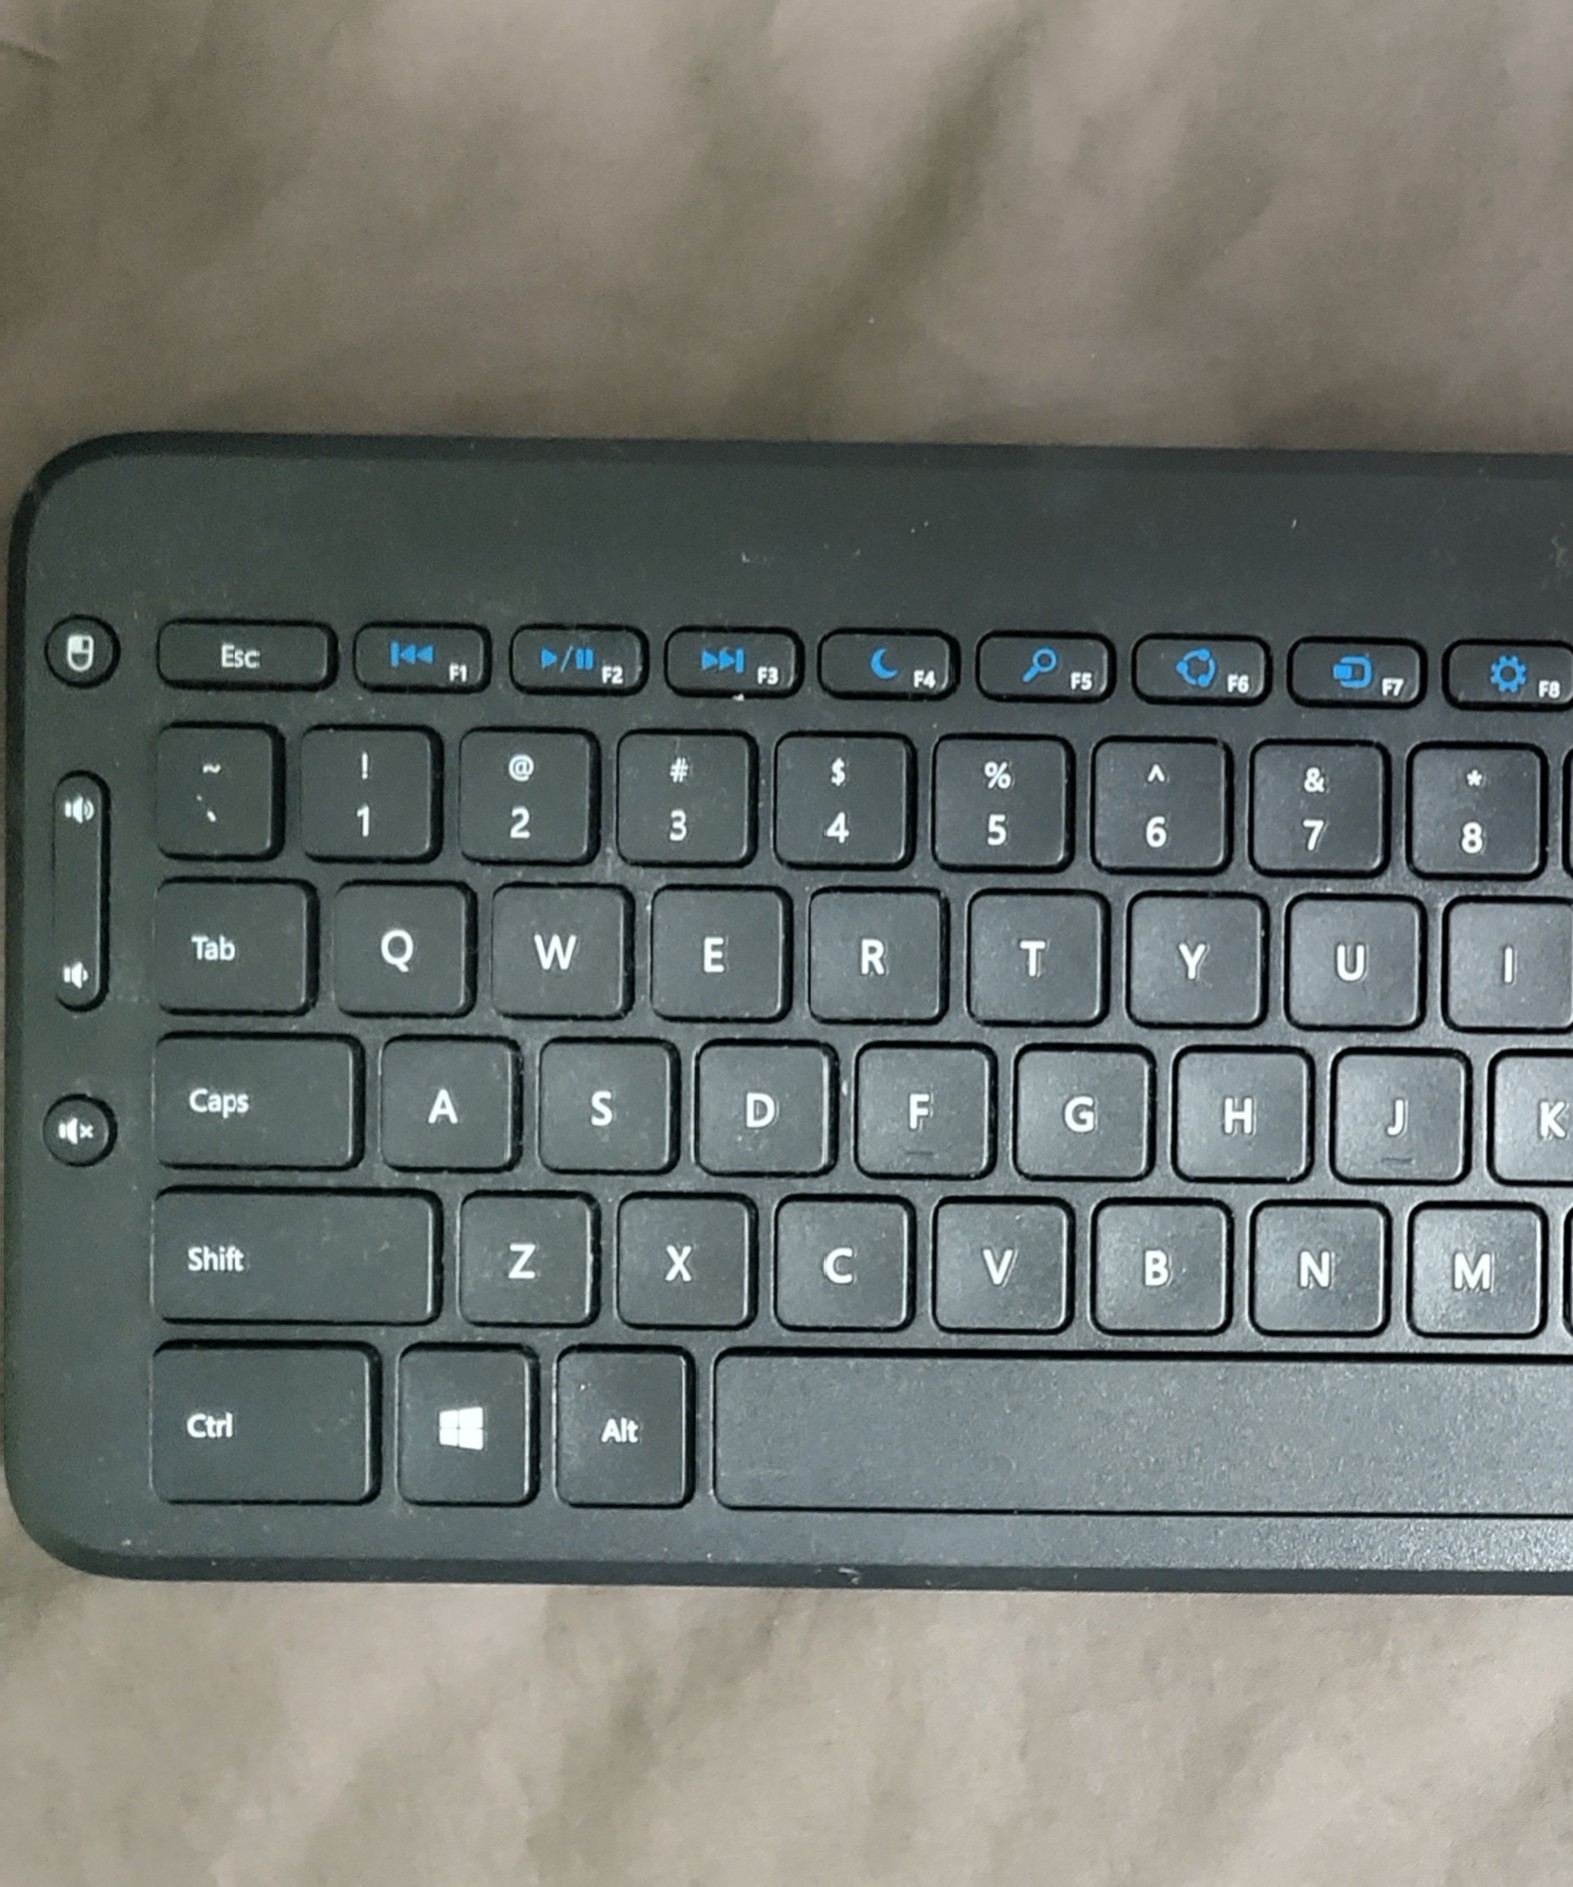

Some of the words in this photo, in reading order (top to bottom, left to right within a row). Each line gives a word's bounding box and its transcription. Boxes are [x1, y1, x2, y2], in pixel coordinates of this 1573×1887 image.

[221, 643, 260, 669] Esc
[449, 663, 467, 682] F1
[601, 665, 624, 684] F2
[757, 666, 779, 685] F3
[913, 669, 936, 689] F4
[1070, 671, 1093, 691] F5
[1227, 674, 1250, 694] F6
[1382, 677, 1404, 696] F7
[1538, 680, 1561, 699] F8
[361, 752, 368, 780] !
[508, 754, 534, 782] @
[669, 757, 689, 783] #
[831, 757, 846, 786] $
[984, 761, 1012, 789] %
[1304, 767, 1325, 793] &
[356, 805, 370, 837] 1
[510, 806, 531, 839] 2
[669, 809, 687, 841] 3
[826, 812, 850, 844] 4
[987, 814, 1007, 846] 5
[1146, 816, 1167, 848] 6
[1303, 819, 1324, 851] 7
[1461, 822, 1483, 854] 8
[191, 935, 236, 961] Tab
[381, 929, 414, 973] Q
[534, 934, 577, 970] W
[703, 936, 725, 973] E
[860, 940, 885, 976] R
[1020, 941, 1046, 977] T
[1178, 943, 1205, 980] Y
[1336, 945, 1365, 981] U
[1503, 948, 1513, 984] I
[189, 1088, 250, 1119] Caps
[428, 1088, 458, 1124] A
[591, 1093, 612, 1126] S
[746, 1093, 776, 1128] D
[909, 1094, 931, 1129] F
[1064, 1096, 1094, 1133] G
[1224, 1098, 1254, 1134] H
[1386, 1100, 1405, 1136] J
[1540, 1102, 1567, 1138] K
[188, 1245, 244, 1272] Shift
[509, 1245, 535, 1279] Z
[665, 1246, 692, 1281] X
[823, 1248, 853, 1284] C
[983, 1250, 1012, 1286] V
[1145, 1252, 1169, 1287] B
[1301, 1252, 1331, 1288] N
[1454, 1254, 1493, 1290] M
[186, 1412, 233, 1438] Ctrl
[601, 1417, 639, 1443] Alt
